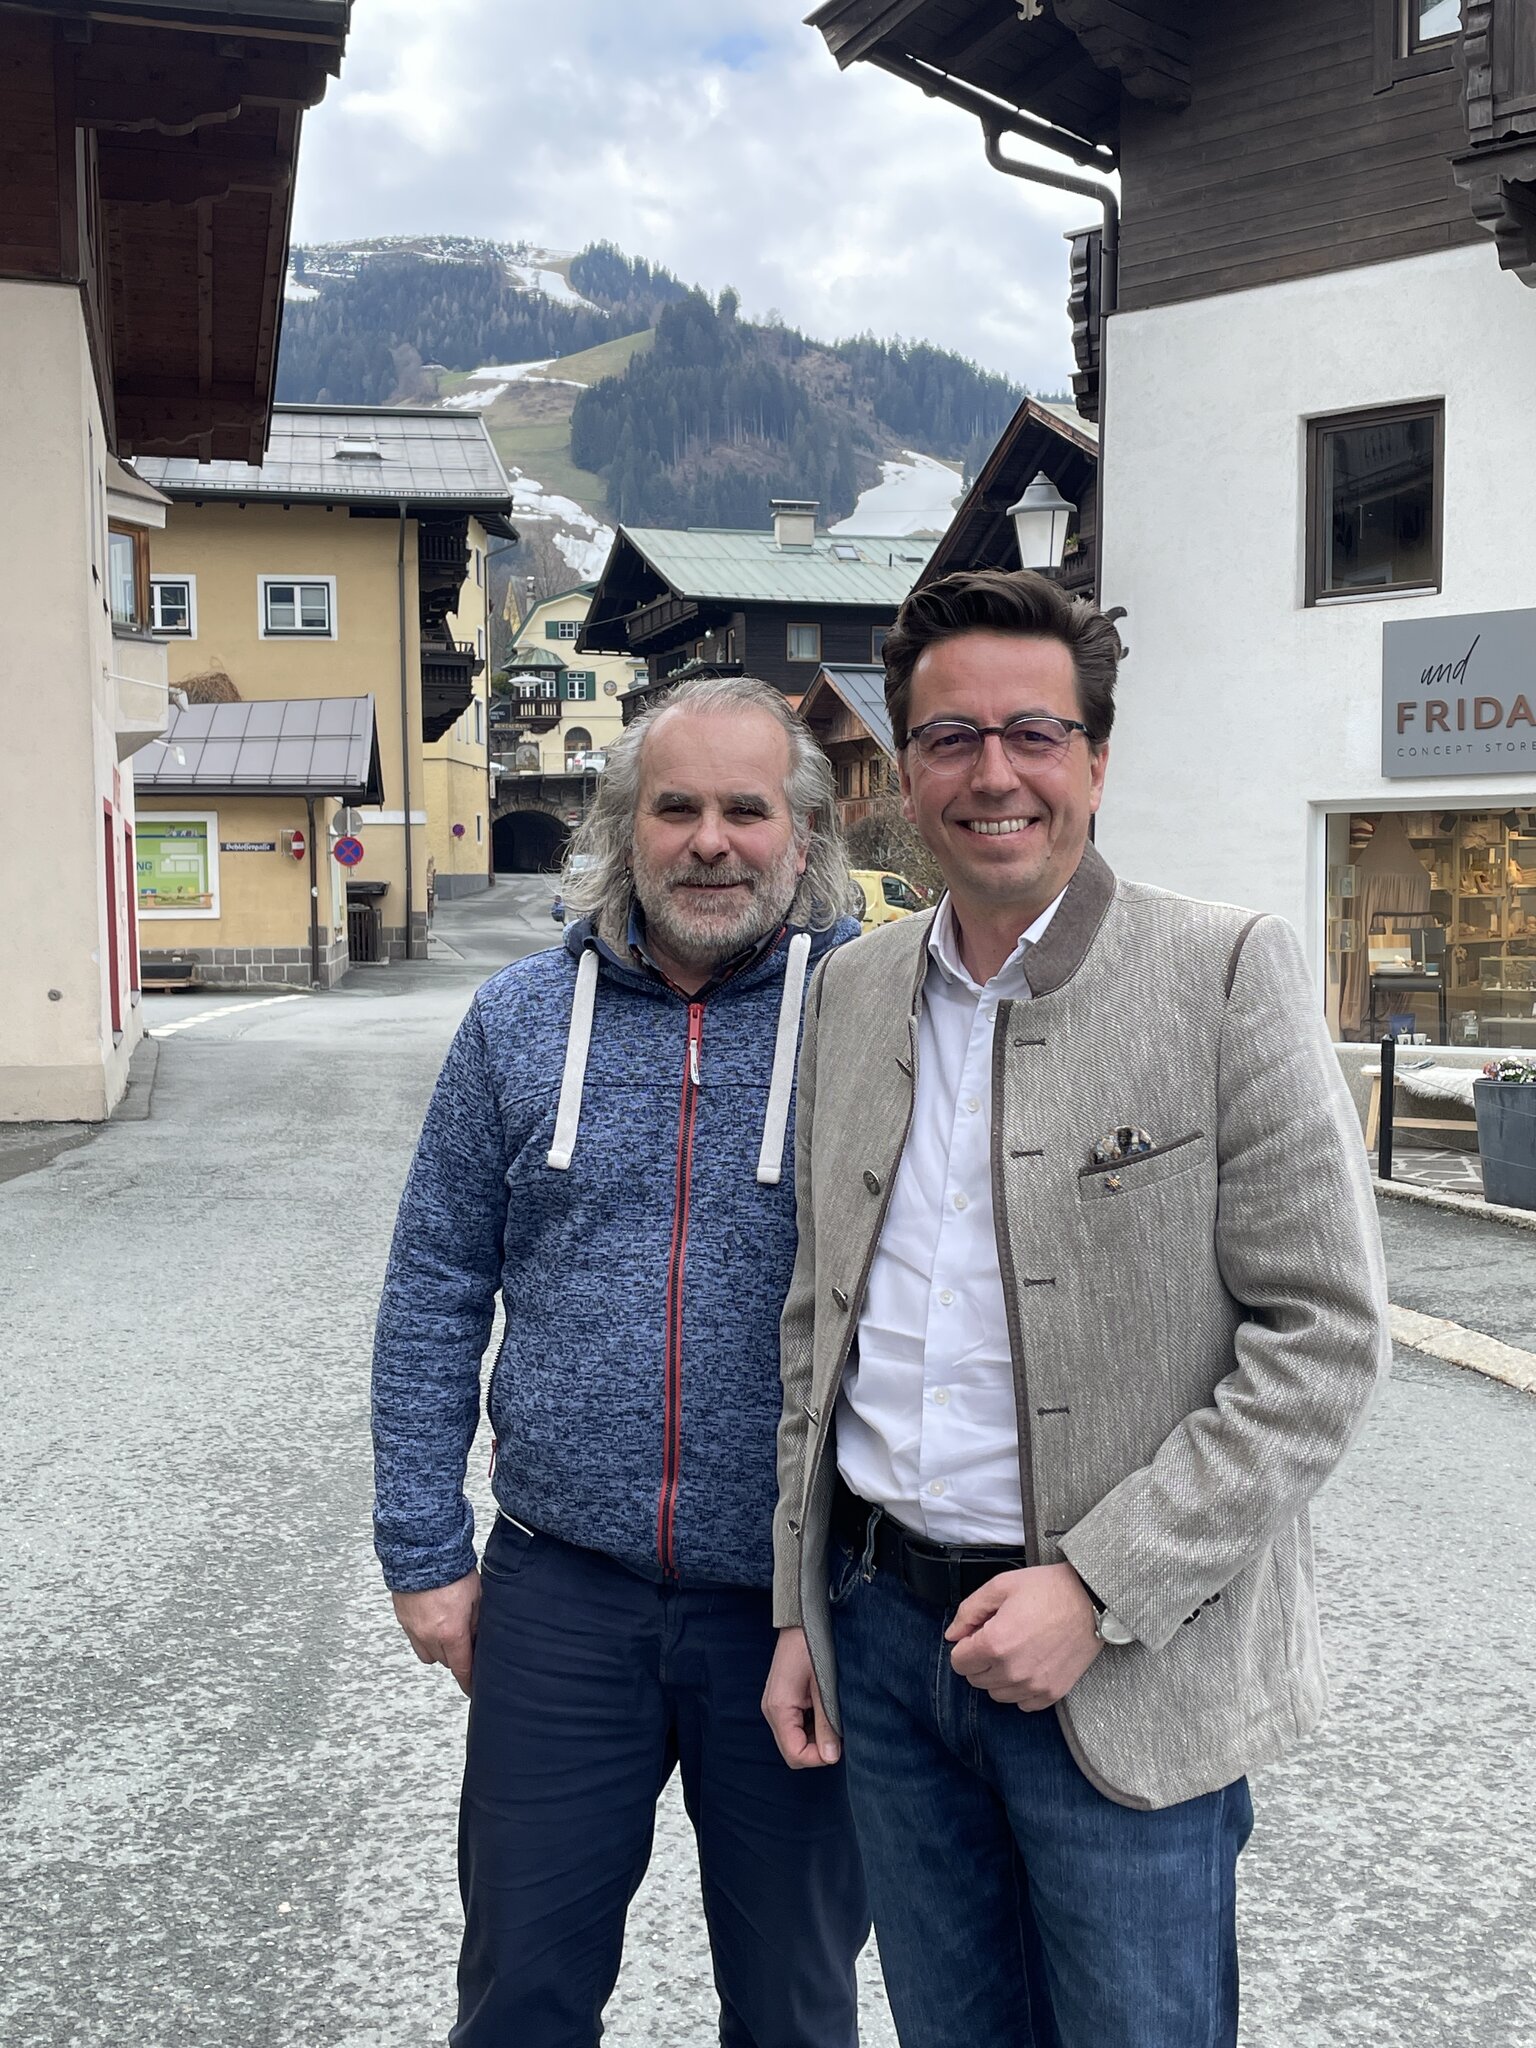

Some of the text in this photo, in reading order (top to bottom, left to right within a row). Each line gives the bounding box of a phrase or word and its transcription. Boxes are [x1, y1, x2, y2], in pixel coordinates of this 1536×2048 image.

[1420, 634, 1481, 685] und
[1397, 694, 1536, 734] FRIDA
[1397, 741, 1536, 757] CONCEPT STORE
